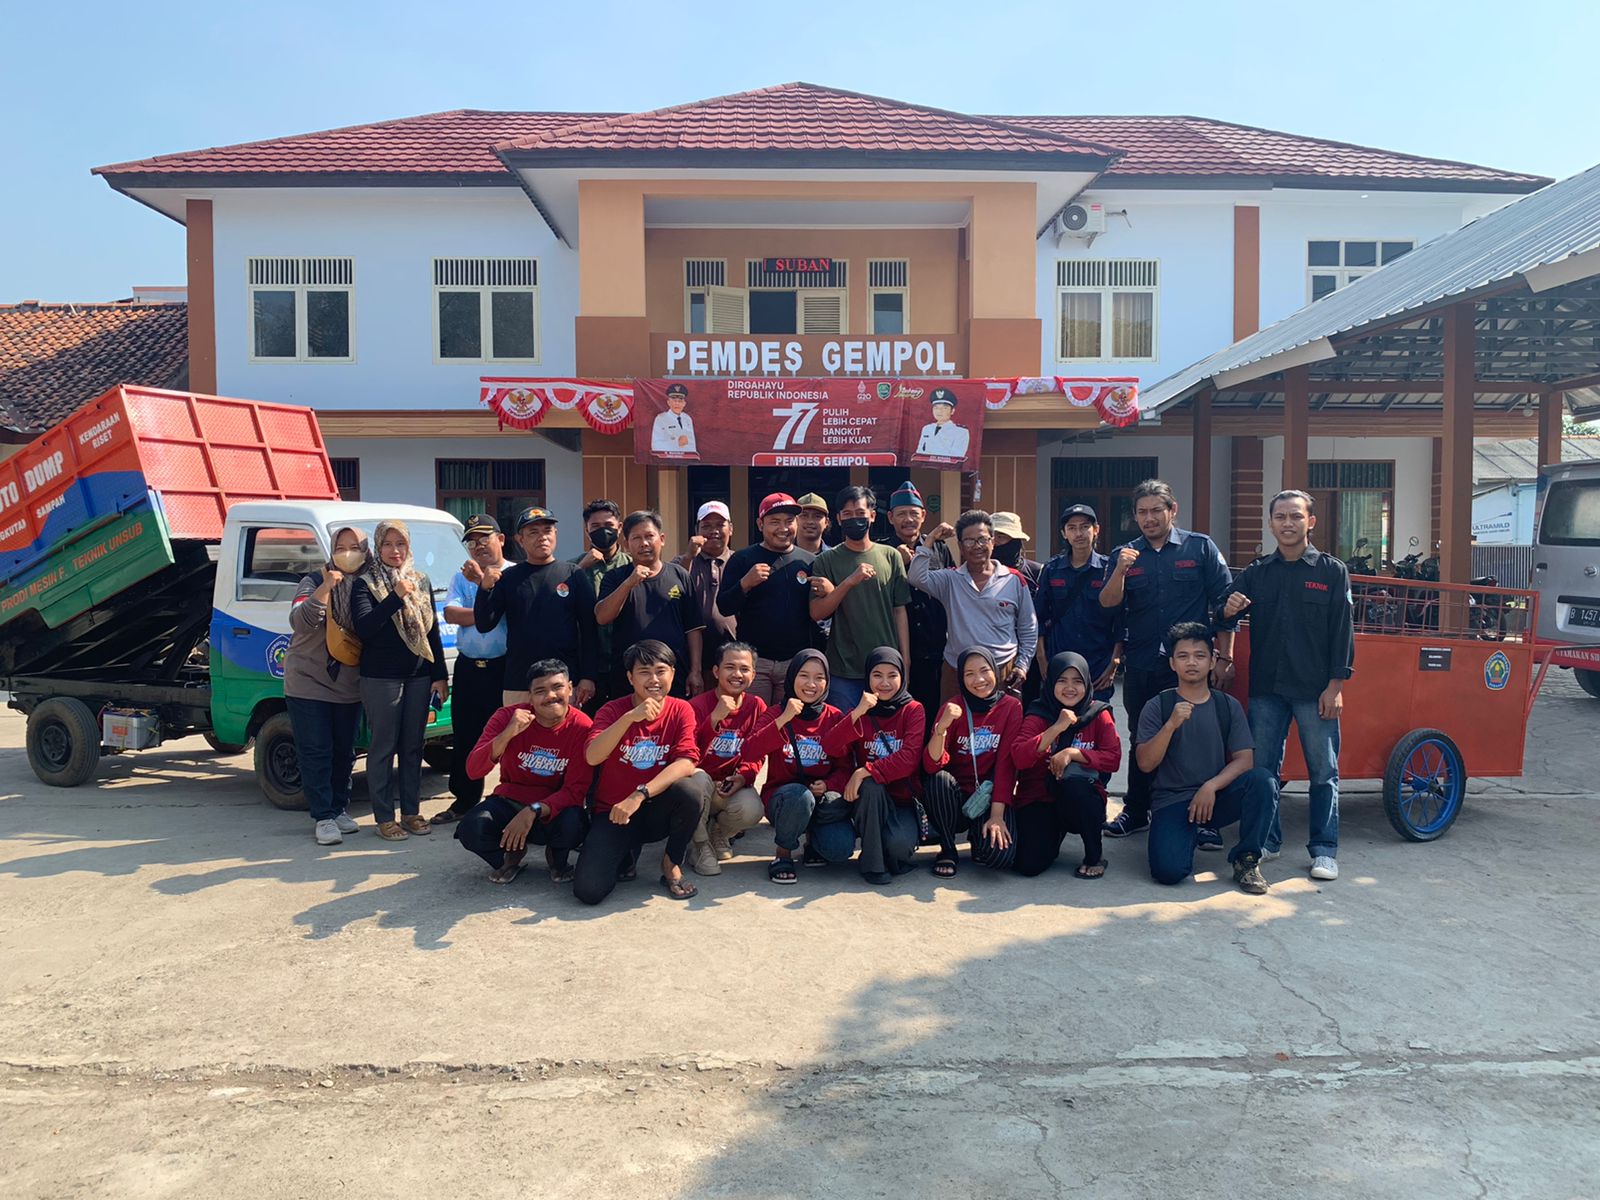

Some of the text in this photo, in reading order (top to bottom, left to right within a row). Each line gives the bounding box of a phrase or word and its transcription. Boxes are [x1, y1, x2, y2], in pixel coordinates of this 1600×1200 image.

[775, 258, 831, 272] SUBAN
[666, 340, 956, 372] PEMDES GEMPOL
[727, 380, 785, 390] DIRGAHAYU
[727, 390, 829, 400] REPUBLIK INDONESIA
[822, 408, 849, 417] PULIH
[79, 412, 120, 444] KENDARAAN
[772, 402, 820, 450] 77
[822, 417, 878, 426] LEBIH CEPAT
[822, 427, 862, 437] BANGKIT
[92, 430, 113, 449] RISET
[822, 436, 873, 445] LEBIH KUAT
[775, 456, 870, 466] PEMDES GEMPOL
[24, 451, 63, 492] DUMP
[36, 494, 66, 519] SAMPAH
[1, 587, 29, 612] PRODI
[29, 572, 58, 597] MESIN
[72, 543, 108, 570] TEKNIK
[108, 522, 143, 550] UNSUB
[1570, 608, 1599, 621] B 1457
